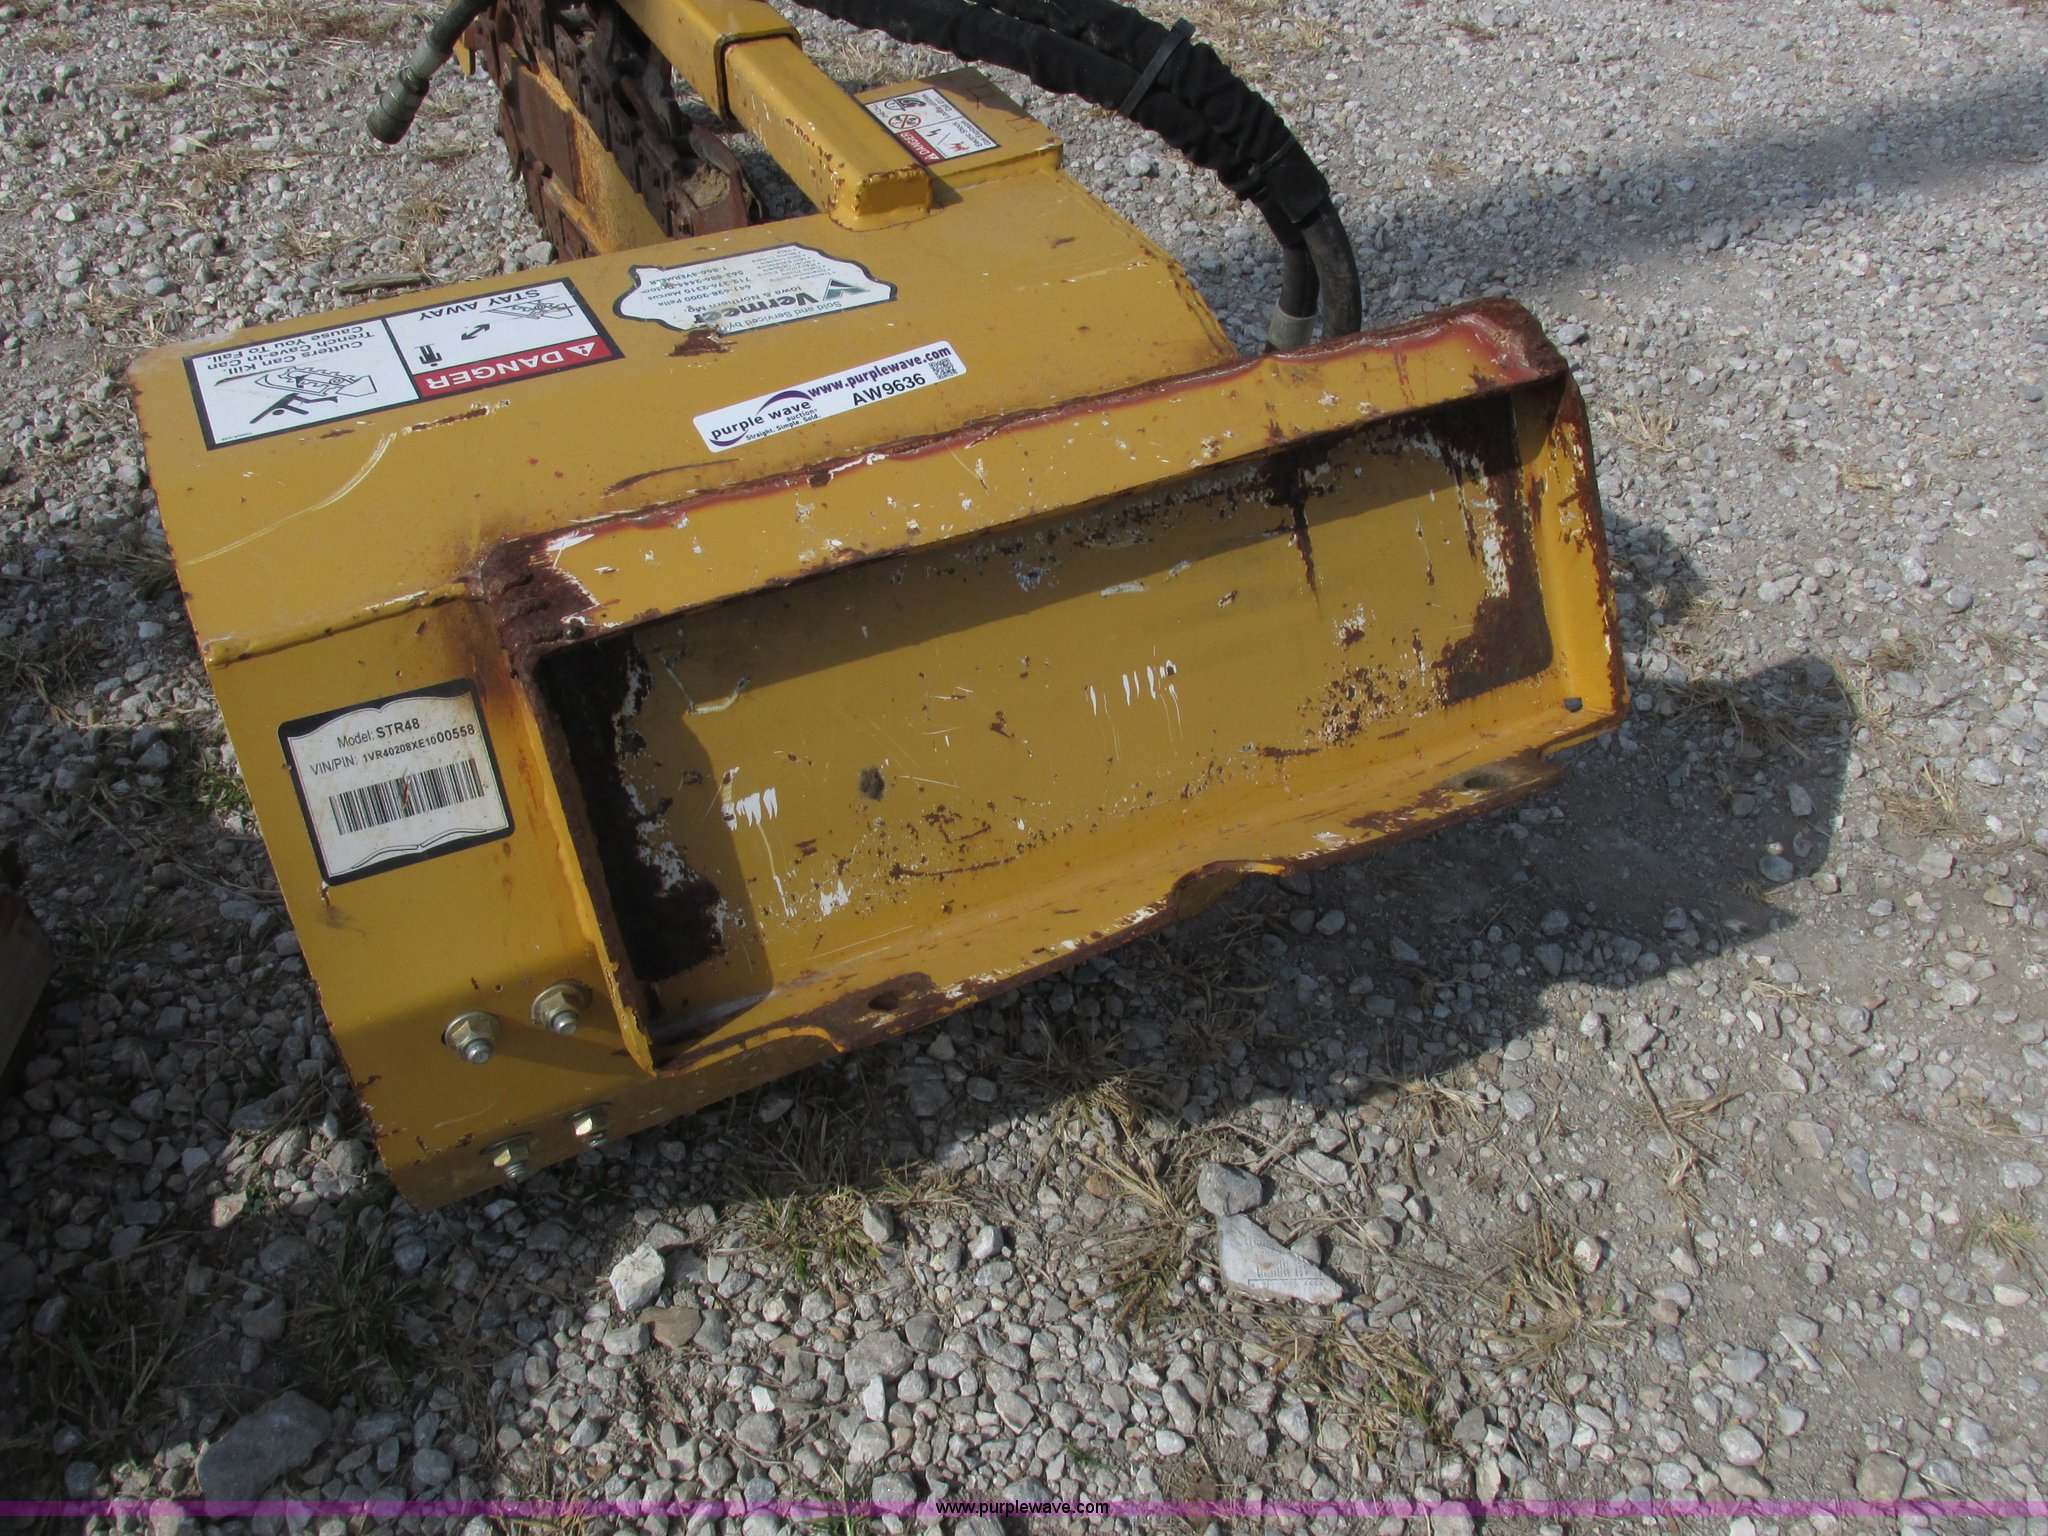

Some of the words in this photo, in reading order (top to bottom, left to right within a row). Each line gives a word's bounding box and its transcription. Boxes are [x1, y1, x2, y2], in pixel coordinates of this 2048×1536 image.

[900, 132, 929, 156] DANGER
[488, 288, 540, 308] STAY
[648, 292, 682, 301] Marcus
[763, 291, 772, 299] &
[774, 285, 802, 296] Iowa
[658, 298, 682, 307] Pella
[693, 292, 818, 326] Vermeer
[707, 293, 760, 309] Northern
[817, 300, 842, 312] Sold
[417, 300, 479, 321] AWAY
[744, 311, 792, 326] Serviced
[794, 306, 814, 317] and
[309, 325, 364, 340] Cause
[316, 331, 375, 349] Trench
[246, 343, 268, 354] To
[272, 337, 306, 350] You
[300, 340, 363, 360] Cutters
[207, 349, 242, 364] Fall.
[246, 342, 314, 363] Cave-In
[261, 353, 296, 368] Can
[207, 356, 242, 372] Can
[221, 361, 257, 375] Kill.
[425, 350, 564, 390] DANGER
[808, 345, 951, 397] www.purplewave.com
[852, 373, 926, 406] AW9636
[711, 414, 764, 440] purple
[768, 400, 811, 420] wave
[746, 426, 776, 441] Straight.
[776, 419, 803, 431] Simple.
[803, 413, 821, 423] Sold.
[337, 731, 375, 749] Model:
[376, 718, 420, 739] STR48
[311, 755, 359, 775] VIN/PIN:
